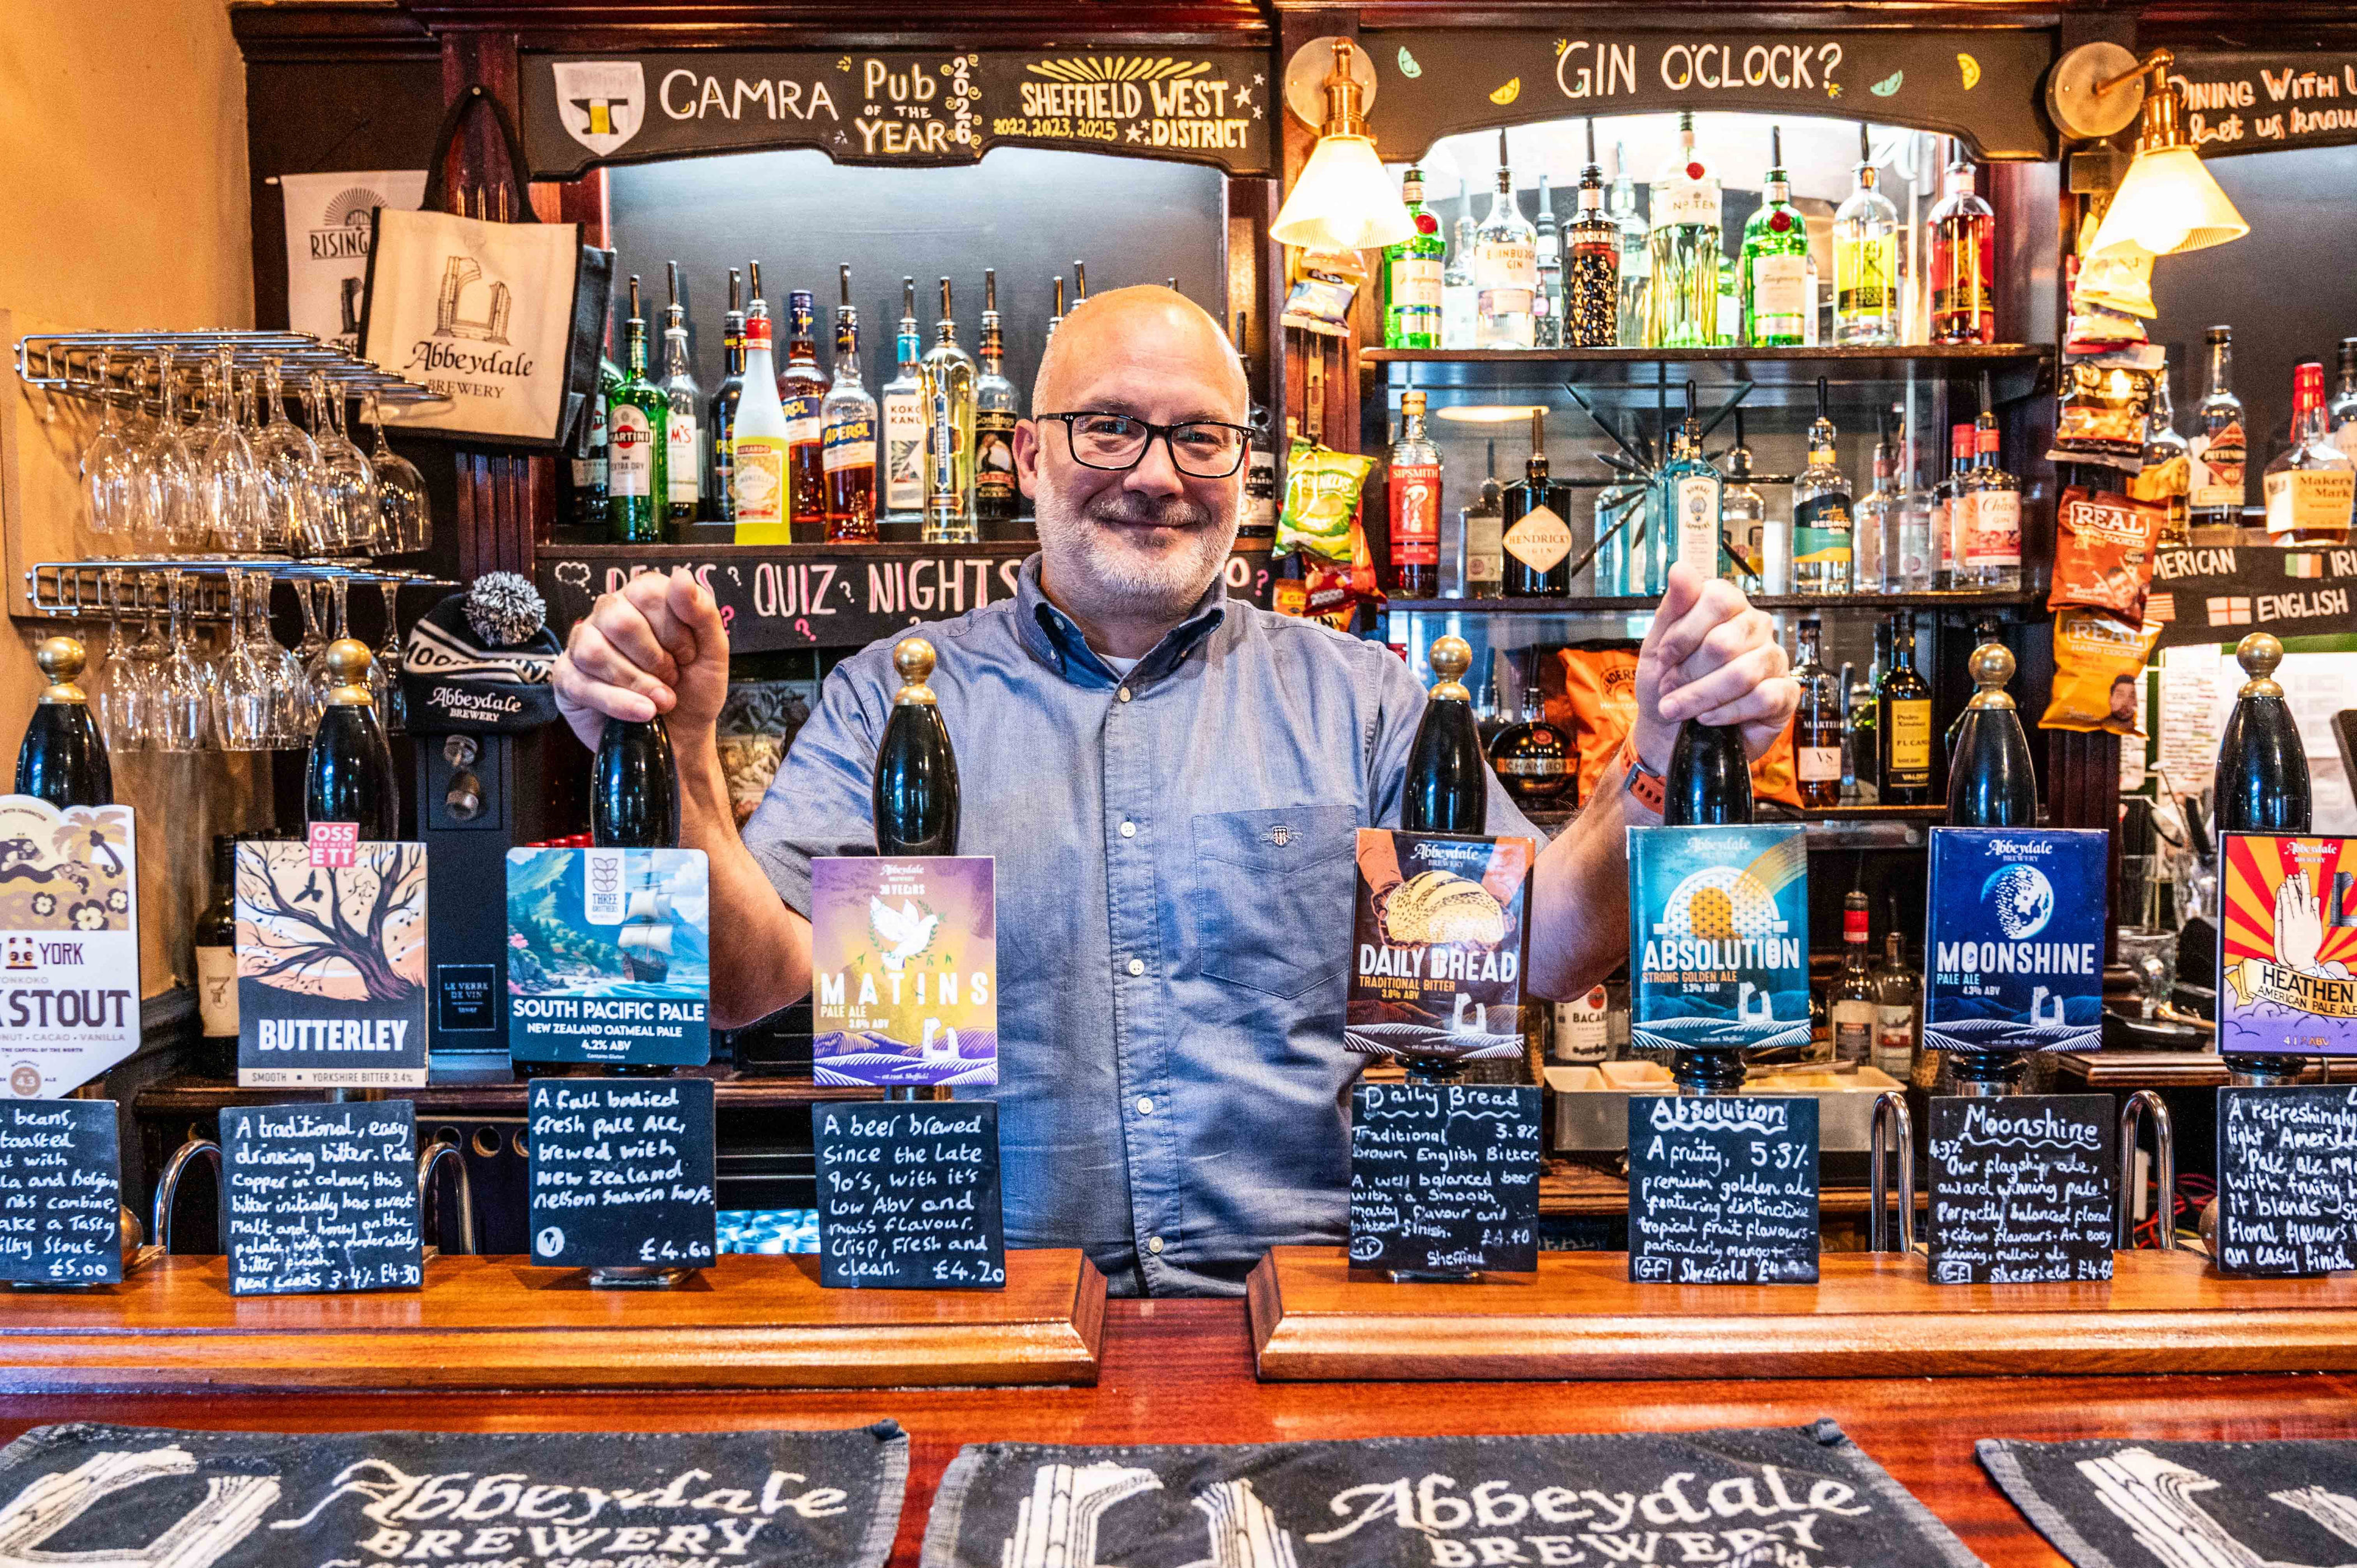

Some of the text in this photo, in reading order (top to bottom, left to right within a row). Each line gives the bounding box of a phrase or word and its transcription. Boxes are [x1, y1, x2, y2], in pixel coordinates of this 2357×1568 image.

[865, 59, 936, 102] Pub
[1557, 40, 1843, 99] GIN O'CLOCK?
[659, 69, 839, 121] CAMRA
[1021, 79, 1229, 119] SHEFFIELD WEST
[863, 105, 932, 120] OF THE
[854, 118, 948, 153] YEAR
[1077, 119, 1119, 141] 2025
[1152, 119, 1249, 148] DISTRICT
[2255, 114, 2285, 140] us
[311, 231, 369, 260] RISING
[1507, 260, 1523, 269] GIN
[404, 340, 533, 377] Abbeydale
[608, 431, 650, 443] MARTINI
[823, 421, 871, 445] APEROL
[1393, 468, 1438, 478] SIPSMITH
[2314, 486, 2350, 498] Mark
[2074, 506, 2144, 534] REAL
[753, 558, 1023, 618] QUIZ NIGHTS
[2257, 588, 2349, 622] ENGLISH
[2073, 623, 2143, 647] REAL
[427, 687, 523, 713] Abbeydale
[449, 708, 499, 722] BREWERY
[314, 825, 354, 841] OSS
[311, 848, 353, 865] ETT
[1409, 843, 1479, 861] Abbeydale
[1984, 839, 2053, 856] Abbeydale
[2284, 842, 2337, 856] Abbeydale
[880, 864, 925, 876] Abbeydale
[592, 894, 618, 904] THREE
[892, 884, 925, 895] YEARS
[39, 943, 84, 965] YORK
[1359, 943, 1518, 983] DAILY BREAD
[1642, 937, 1800, 971] ABSOLUTION
[1937, 941, 2095, 974] MOONSHINE
[1358, 975, 1455, 992] TRADITIONAL BITTER
[1642, 970, 1737, 983] STRONG GOLDEN ALE
[1937, 973, 1980, 985] PALE ALE
[2262, 965, 2354, 1003] HEATHEN
[821, 972, 988, 1005] MATINS
[1403, 989, 1419, 1000] ABV
[1683, 983, 1720, 993] 5.3% ABV
[1962, 986, 2000, 996] 4.3% ABV
[9, 989, 132, 1027] STOUT
[512, 999, 705, 1021] SOUTH PACIFIC PALE
[2257, 985, 2357, 1015] AMERICAN PALE ALE
[821, 1006, 866, 1017] PALE ALE
[259, 1019, 409, 1051] BUTTERLEY
[527, 1023, 682, 1037] NEW ZEALAND OATMEAL PALE
[873, 1019, 889, 1029] ABV
[582, 1040, 631, 1050] 4.2% ABV
[2309, 1036, 2330, 1046] ABV
[252, 1072, 413, 1082] SMOOTH YORKSHIRE BITTER 3.4%
[535, 1088, 679, 1109] A bodied
[1365, 1085, 1519, 1118] Daily Bread
[2228, 1097, 2244, 1121] A
[1651, 1096, 1785, 1125] Absolution
[235, 1116, 252, 1139] A
[824, 1113, 982, 1137] A beer brewed
[1964, 1104, 2098, 1142] Moonshine
[235, 1142, 315, 1175] drinking
[619, 1139, 676, 1159] with
[894, 1146, 927, 1164] the
[1416, 1146, 1477, 1172] English
[1646, 1135, 1665, 1161] A
[24, 1153, 68, 1167] with
[1946, 1156, 1979, 1176] Our
[28, 1172, 67, 1187] and
[890, 1168, 979, 1187] with it's
[1419, 1171, 1492, 1187] balanced
[1642, 1170, 1780, 1201] premium golden
[921, 1190, 974, 1212] and
[1997, 1177, 2058, 1203] winning
[275, 1191, 339, 1221] initially
[1477, 1207, 1507, 1222] and
[2009, 1202, 2070, 1222] balanced
[2255, 1191, 2321, 1218] blends
[275, 1215, 309, 1234] and
[1640, 1216, 1698, 1240] tropical
[948, 1234, 988, 1252] and
[49, 1258, 108, 1276] £5.00
[933, 1259, 1005, 1283] £4.20
[269, 1457, 849, 1532] Abbeydale
[1305, 1463, 1872, 1544] Abbeydale
[356, 1517, 775, 1559] BREWERY
